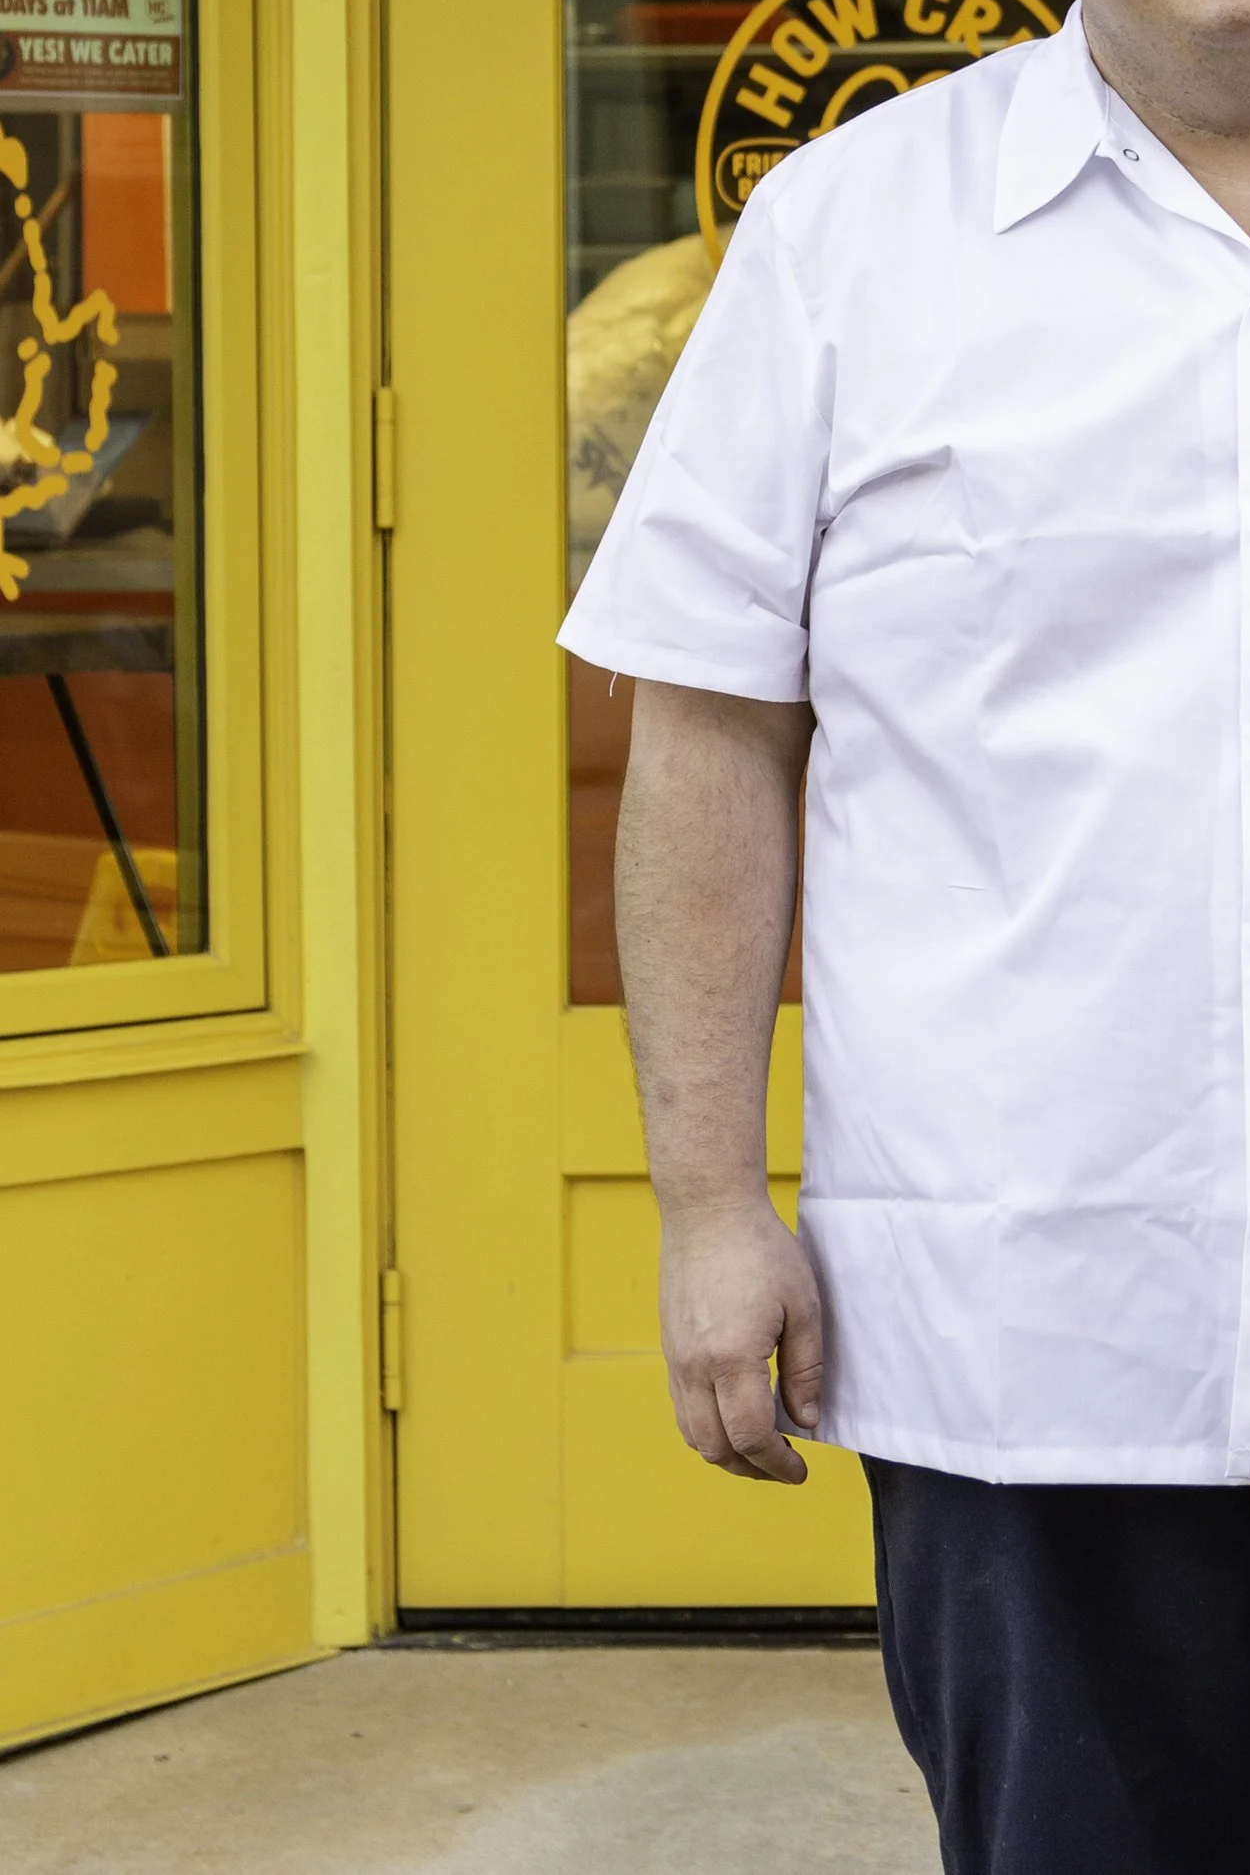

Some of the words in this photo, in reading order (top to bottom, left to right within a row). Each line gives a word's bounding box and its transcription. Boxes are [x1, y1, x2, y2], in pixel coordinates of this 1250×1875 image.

[18, 36, 65, 64] YES!
[70, 38, 104, 65] WE
[108, 40, 173, 67] CATER
